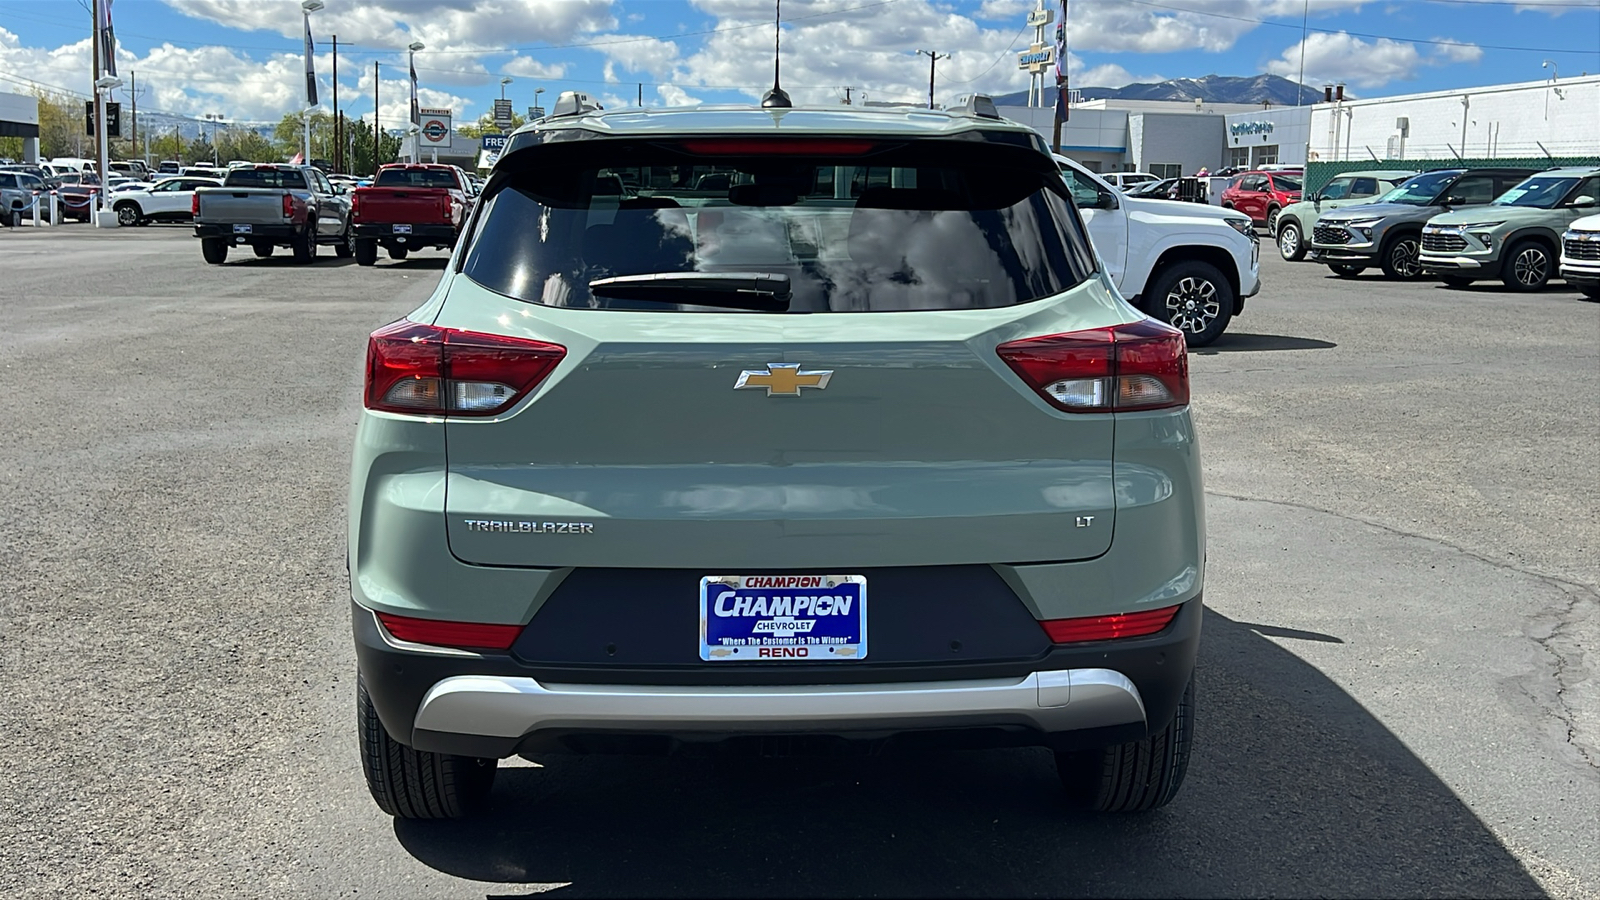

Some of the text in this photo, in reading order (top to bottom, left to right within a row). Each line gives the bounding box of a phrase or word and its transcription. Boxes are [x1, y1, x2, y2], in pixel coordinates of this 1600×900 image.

[464, 519, 594, 534] TRAILBLAZER
[1076, 516, 1095, 527] LT
[745, 577, 822, 588] CHAMPION
[714, 591, 853, 617] CHAMPION
[756, 622, 811, 631] CHEVROLET
[747, 637, 761, 645] The
[762, 637, 797, 645] Customer
[798, 637, 806, 645] Is
[806, 637, 820, 645] The
[759, 648, 809, 657] RENO
